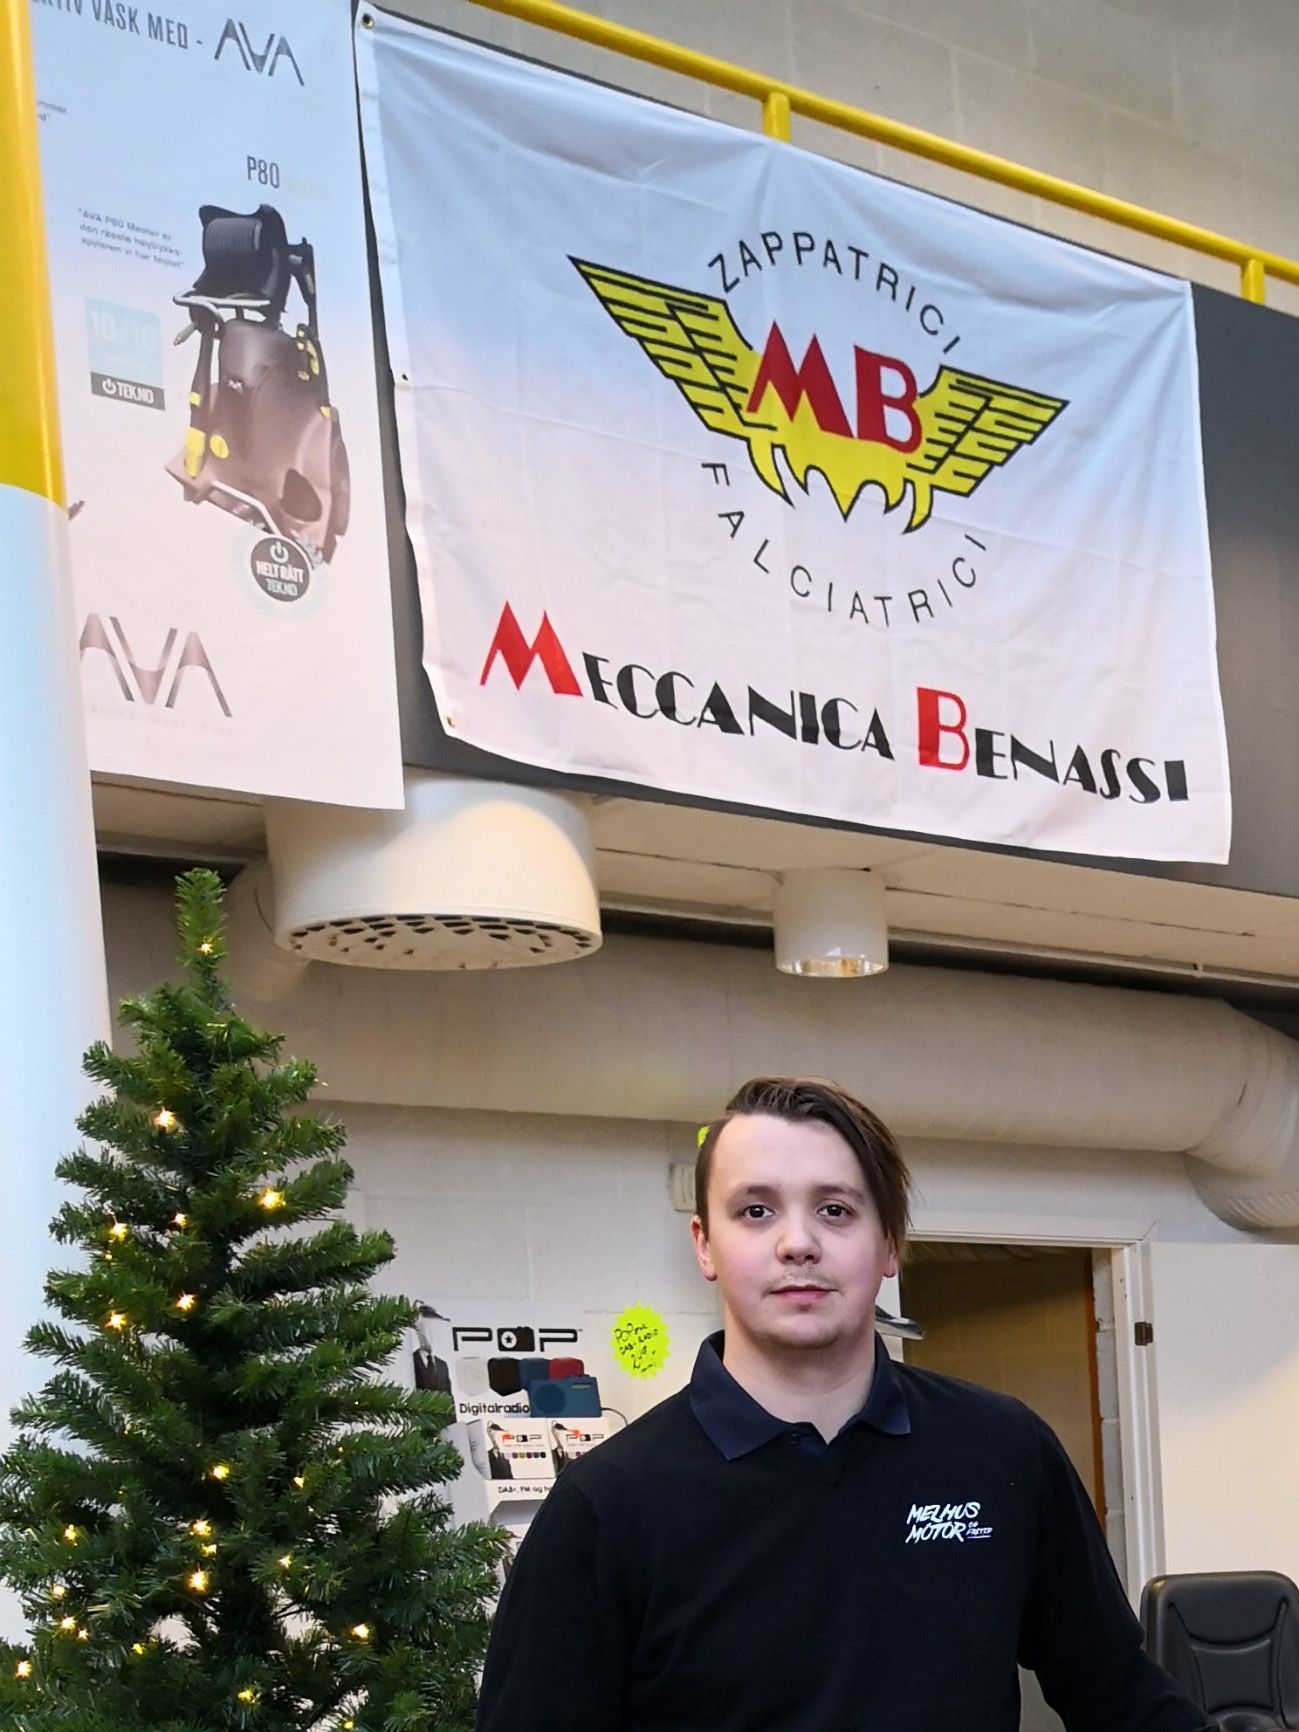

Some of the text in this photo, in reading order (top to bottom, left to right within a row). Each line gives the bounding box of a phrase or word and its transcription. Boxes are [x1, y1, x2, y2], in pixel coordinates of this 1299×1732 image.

[91, 0, 140, 35] VASK
[147, 12, 188, 49] MED
[214, 18, 305, 87] AVA
[246, 155, 280, 190] P80
[708, 231, 961, 354] ZAPPATRICI
[747, 320, 922, 454] MB
[702, 462, 987, 628] FALCIATRICI
[480, 600, 1190, 804] MECCANICA BENASSI
[459, 1402, 530, 1416] Digitalradio
[905, 1521, 967, 1544] MOTOR
[907, 1502, 980, 1524] MELHUS
